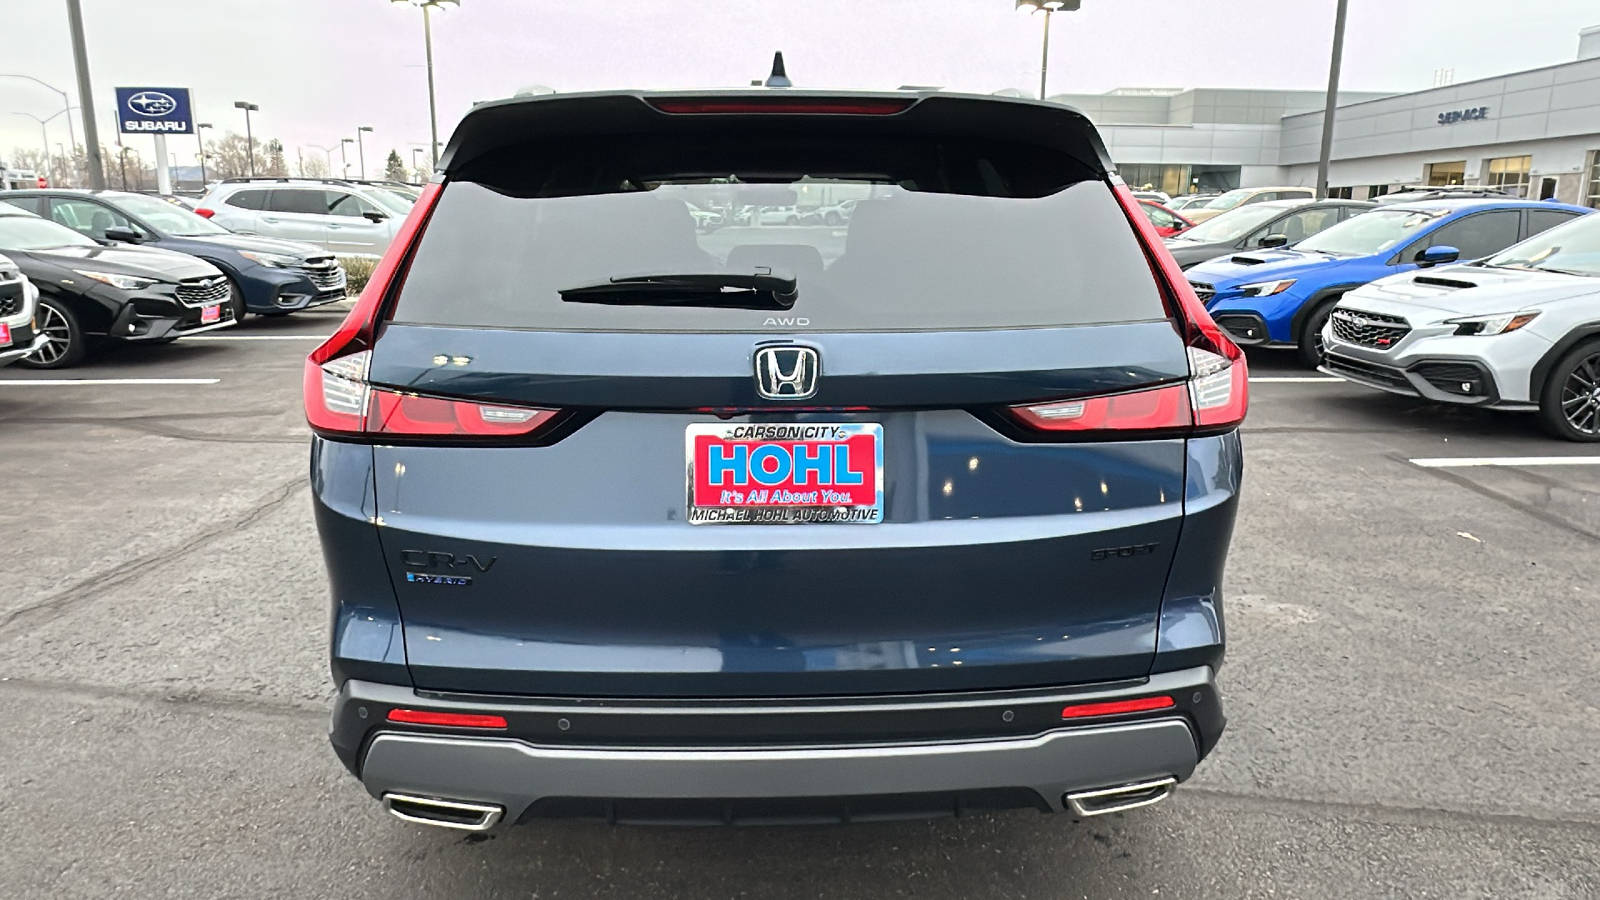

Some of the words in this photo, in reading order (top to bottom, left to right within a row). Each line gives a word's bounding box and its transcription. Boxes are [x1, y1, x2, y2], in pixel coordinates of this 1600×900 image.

[1438, 106, 1489, 125] SERVICE
[125, 120, 187, 131] SUBARU
[763, 317, 810, 326] AWD
[733, 426, 801, 439] CARSON
[803, 426, 840, 439] CITY
[708, 443, 863, 486] HOHL
[720, 489, 744, 504] It's
[747, 489, 769, 504] All
[769, 489, 817, 504] About
[821, 489, 853, 504] You.
[691, 507, 750, 521] MICHAEL
[753, 507, 790, 521] HOHL
[792, 507, 879, 521] AUTOMOTIVE
[1091, 541, 1160, 560] SPORT
[401, 549, 498, 573] CR-V
